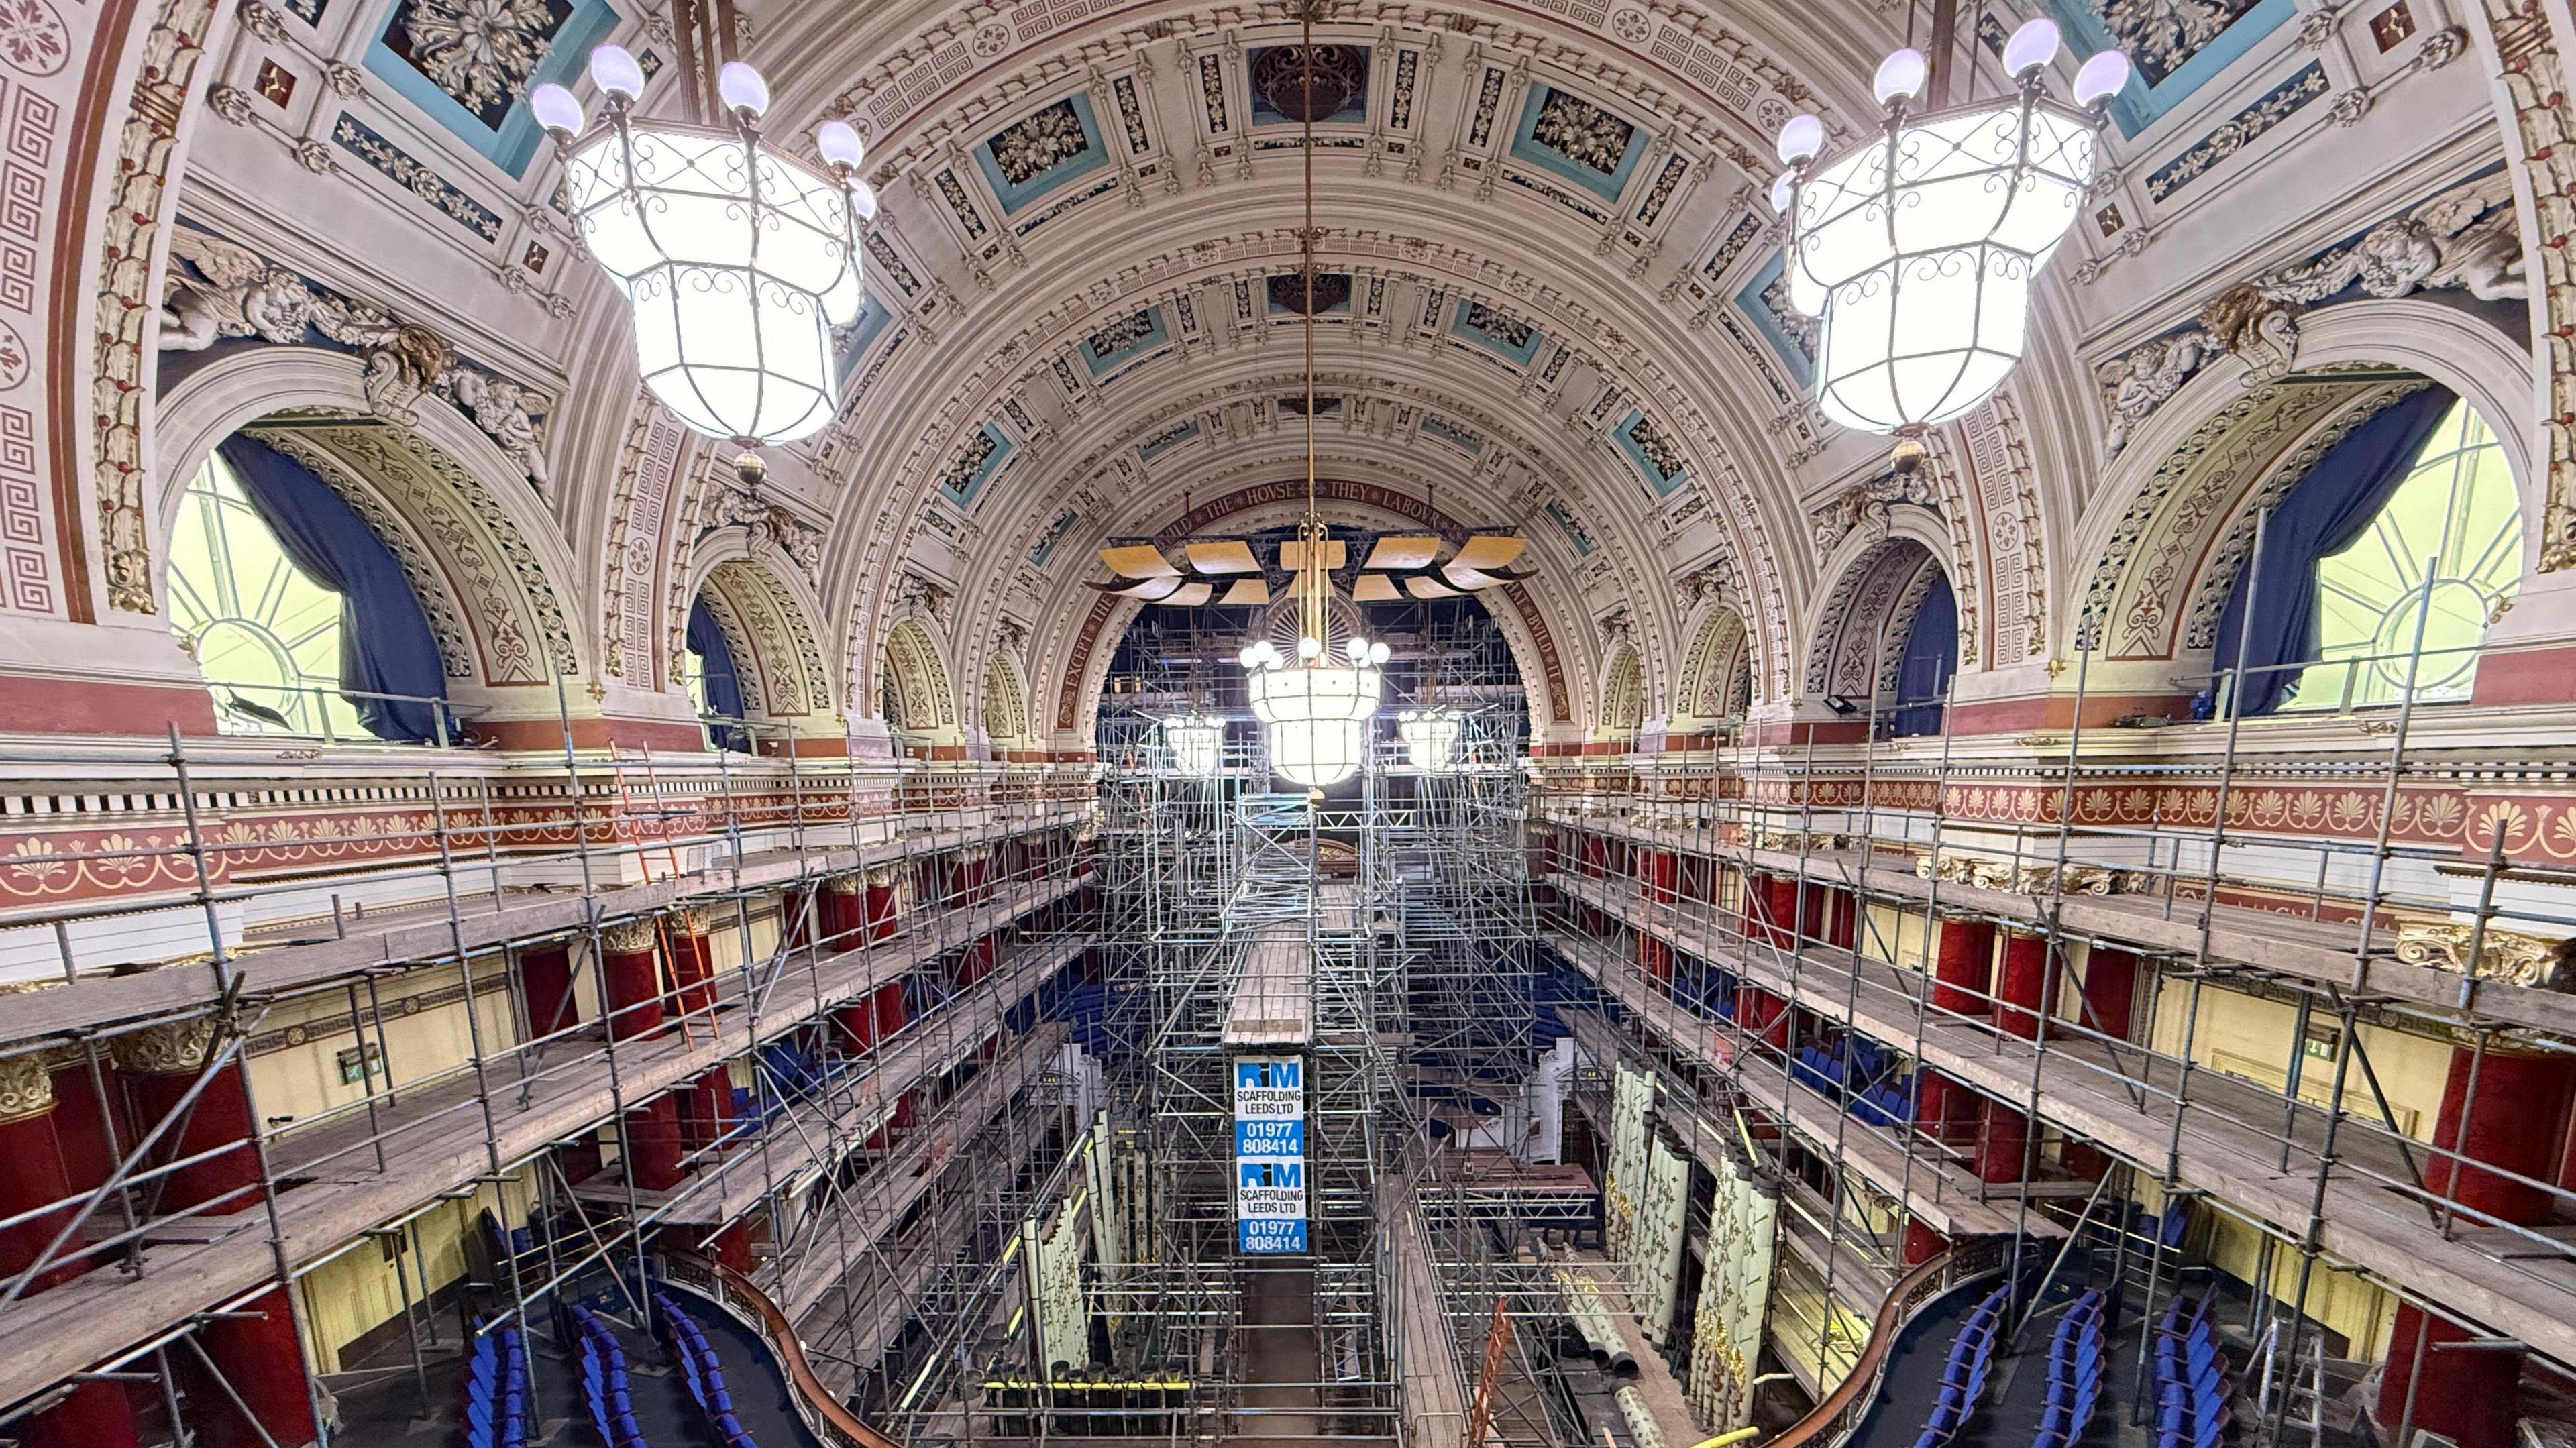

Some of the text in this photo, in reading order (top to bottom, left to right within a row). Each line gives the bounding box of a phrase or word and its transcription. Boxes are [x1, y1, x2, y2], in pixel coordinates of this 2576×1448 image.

[1065, 632, 1093, 687] EXCEPT
[1089, 594, 1114, 622] THE
[1205, 496, 1235, 519] THE
[1246, 481, 1296, 506] HOVSE
[1330, 481, 1371, 500] THEY
[1382, 490, 1440, 529] LABOVR
[1527, 614, 1553, 653] BVILD
[1237, 1090, 1301, 1102] SCAFFOLDING
[1245, 1103, 1294, 1115] LEEDS LTD
[1246, 1122, 1293, 1138] 01977
[1242, 1138, 1299, 1154] 808414
[1240, 1189, 1303, 1201] SCAFFOLDING
[1248, 1202, 1297, 1213] LEEDS LTD
[1249, 1220, 1296, 1235] 01977
[1245, 1235, 1301, 1251] 808414
